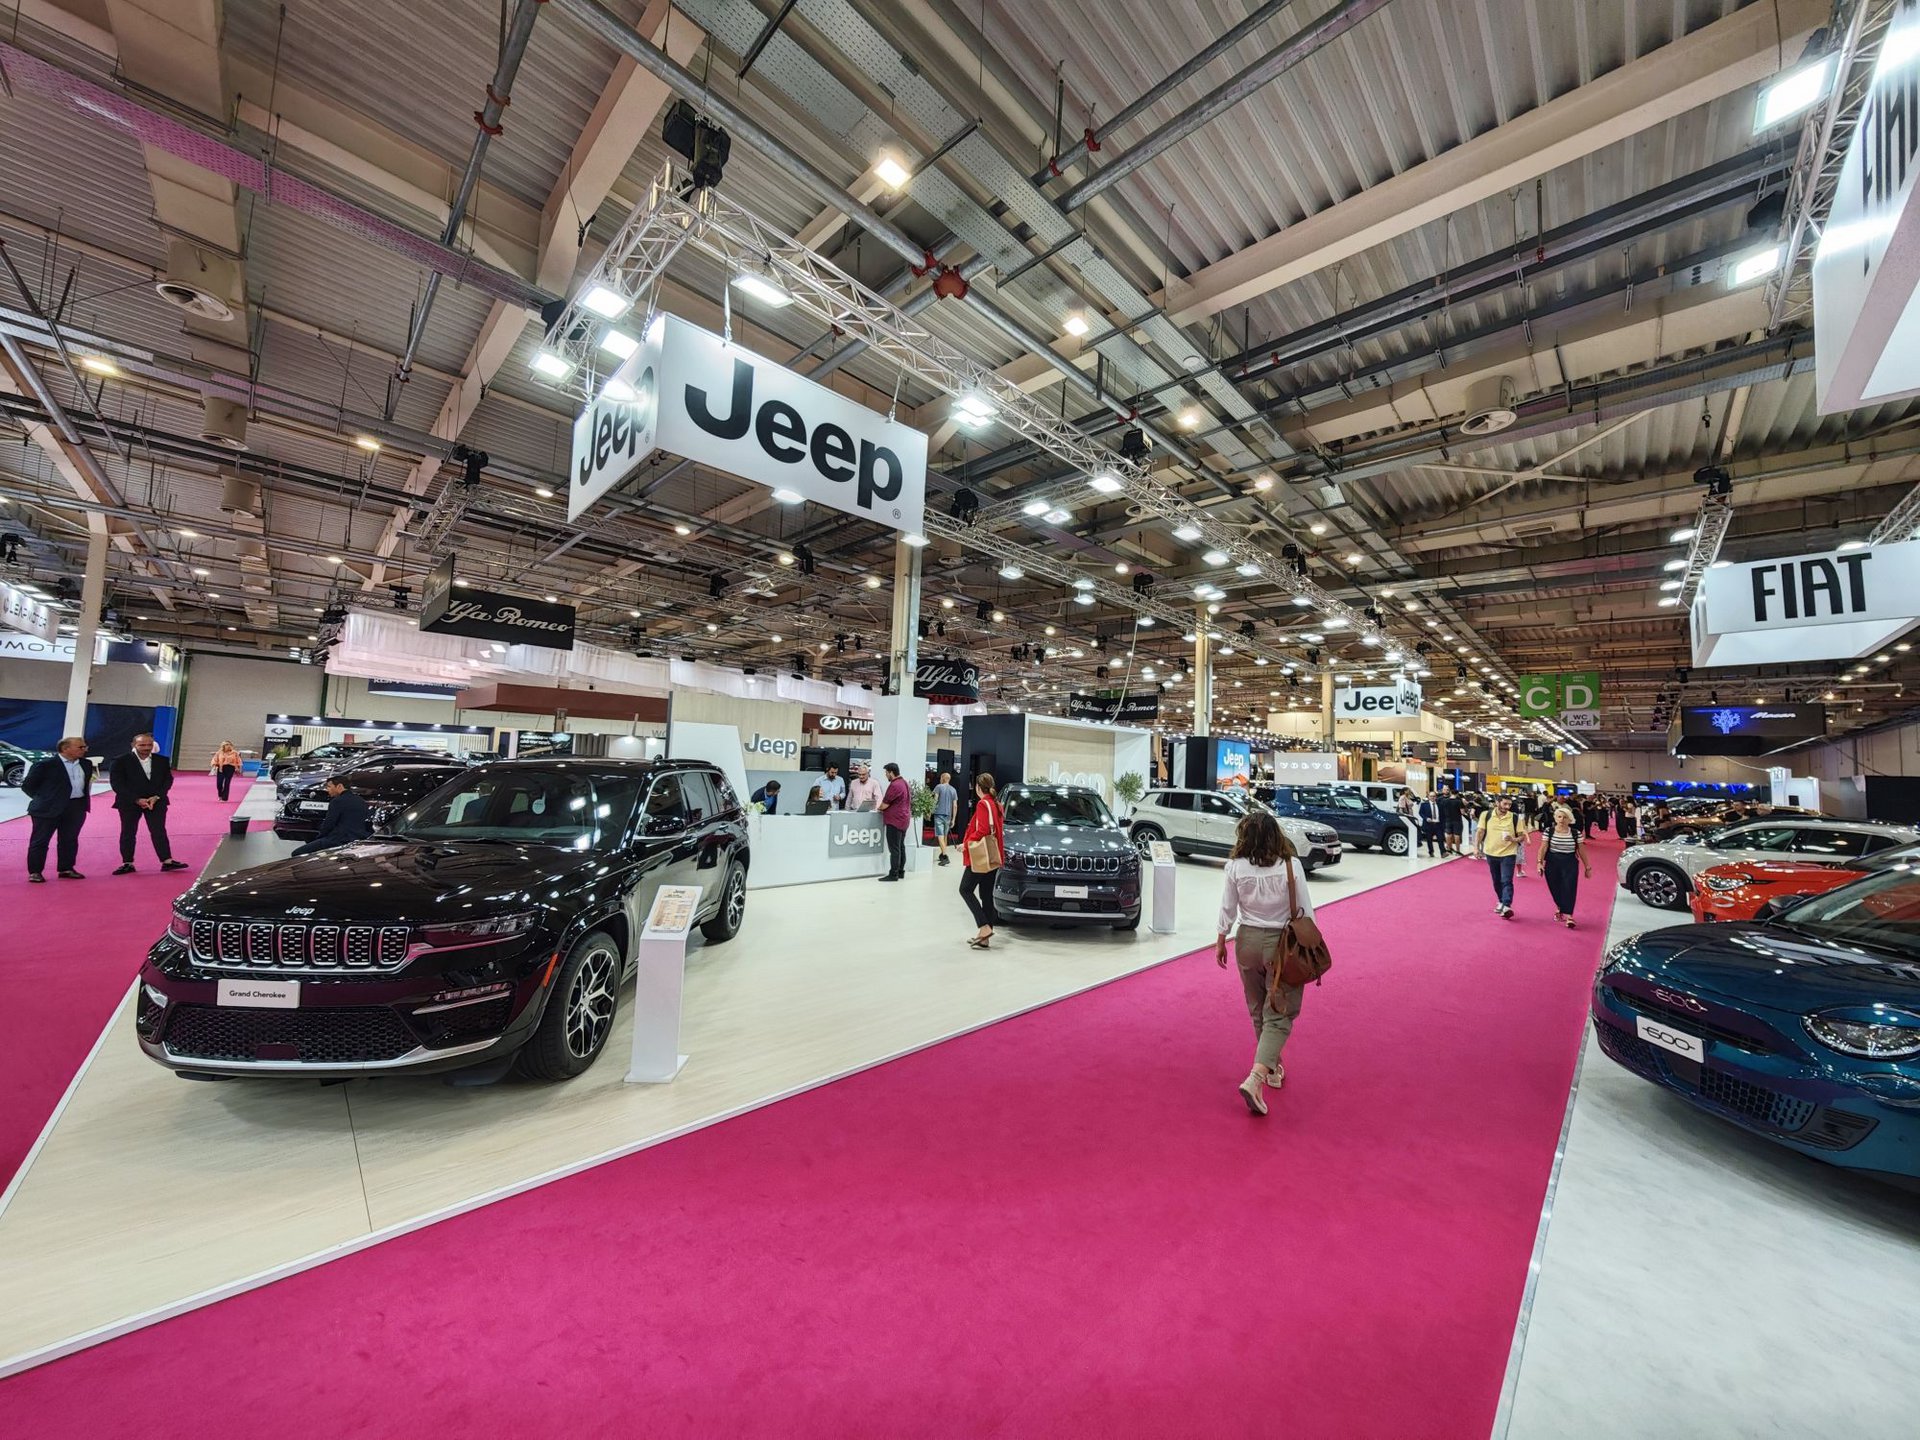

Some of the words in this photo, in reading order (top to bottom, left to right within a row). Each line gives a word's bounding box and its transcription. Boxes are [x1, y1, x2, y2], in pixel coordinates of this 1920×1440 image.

[580, 366, 655, 487] Jeep
[684, 358, 903, 509] Jeep
[1751, 552, 1872, 622] FIAT
[440, 600, 492, 623] lfa
[493, 606, 573, 632] Romeo
[915, 664, 960, 690] Alfa
[1126, 702, 1157, 712] Romeo
[1344, 691, 1401, 715] Jee
[1400, 683, 1419, 713] Jeep
[1525, 686, 1551, 710] C
[1565, 684, 1593, 709] D
[744, 733, 798, 759] Jeep
[1223, 748, 1244, 769] Jeep
[834, 824, 881, 847] Jeep
[285, 905, 315, 915] Jeep
